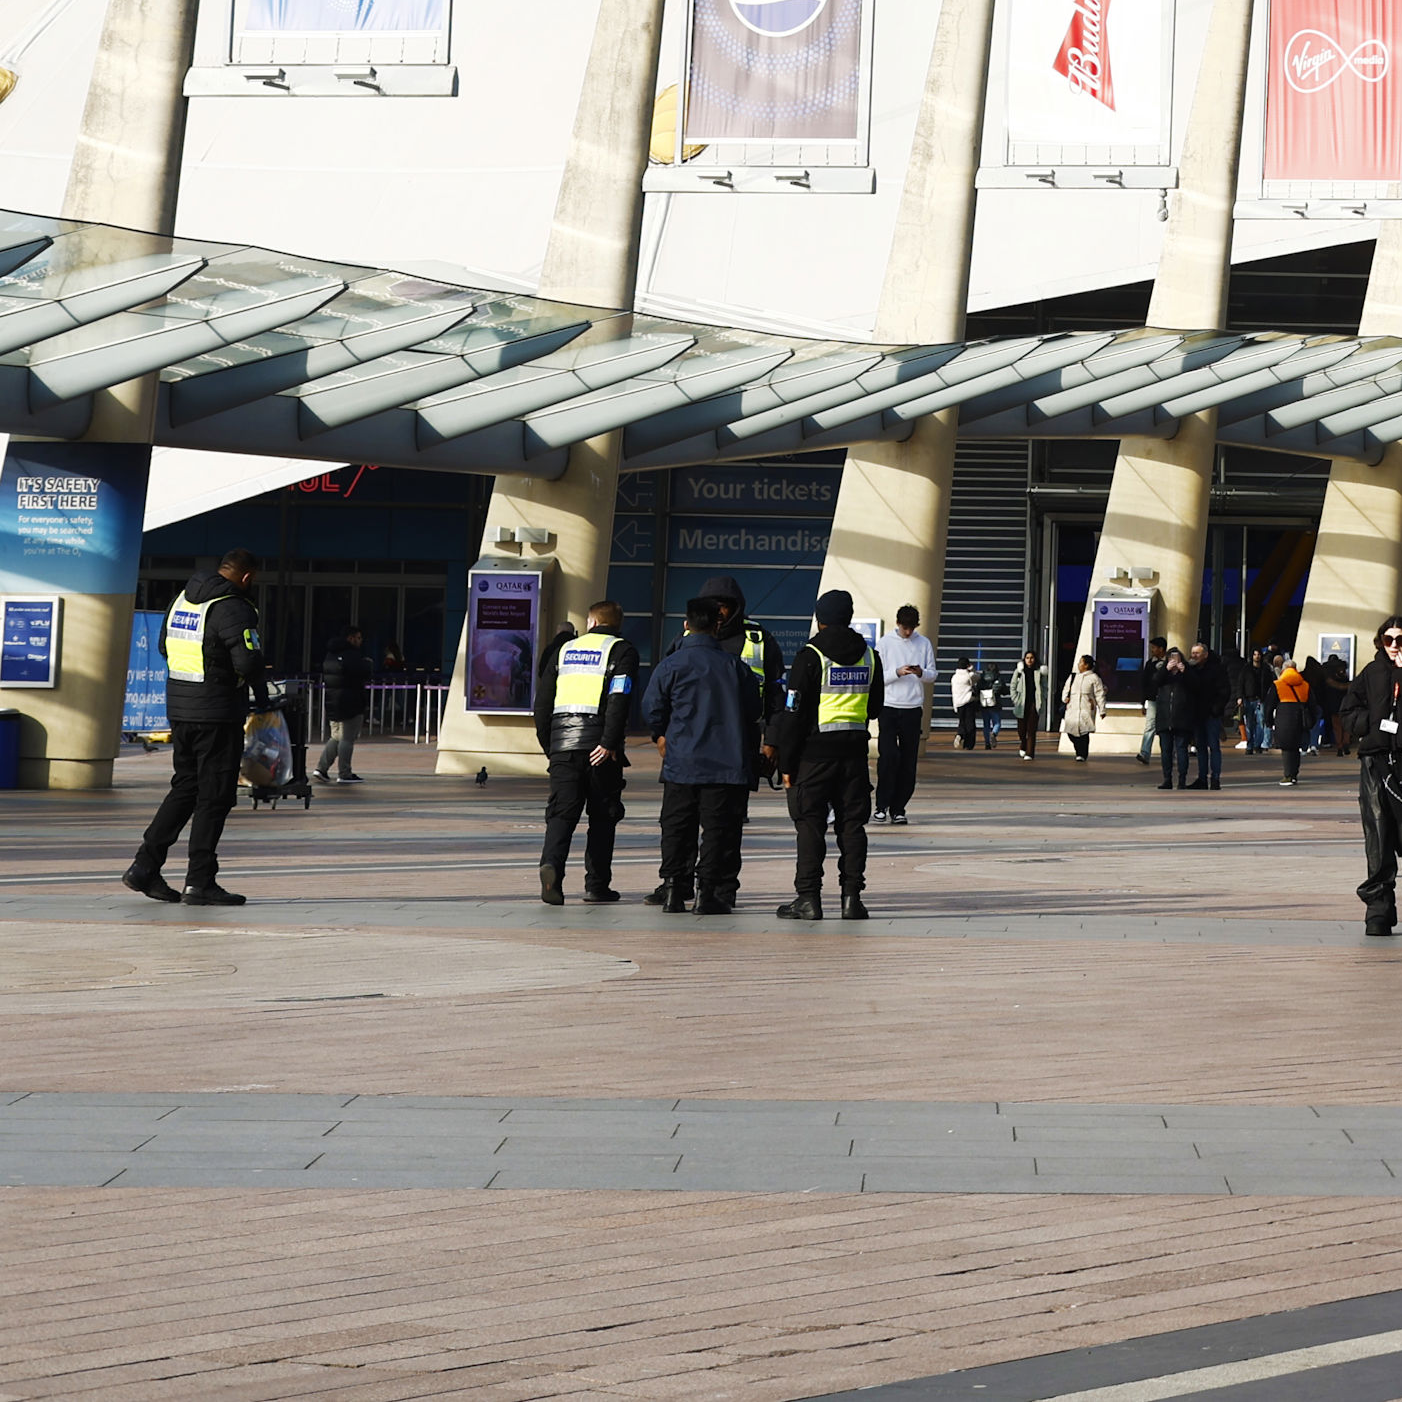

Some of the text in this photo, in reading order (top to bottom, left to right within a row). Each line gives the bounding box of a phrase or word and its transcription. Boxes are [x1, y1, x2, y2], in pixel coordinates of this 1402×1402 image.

[1292, 41, 1385, 82] Virgin media
[17, 477, 100, 493] IT'S SAFETY
[688, 478, 832, 502] Your tickets
[17, 494, 97, 509] FIRST HERE
[18, 515, 30, 523] For
[70, 515, 94, 526] safety,
[60, 527, 93, 535] searched
[496, 582, 522, 590] QATAR
[564, 651, 602, 663] SECURITY
[831, 670, 869, 683] SECURITY
[130, 712, 143, 727] will
